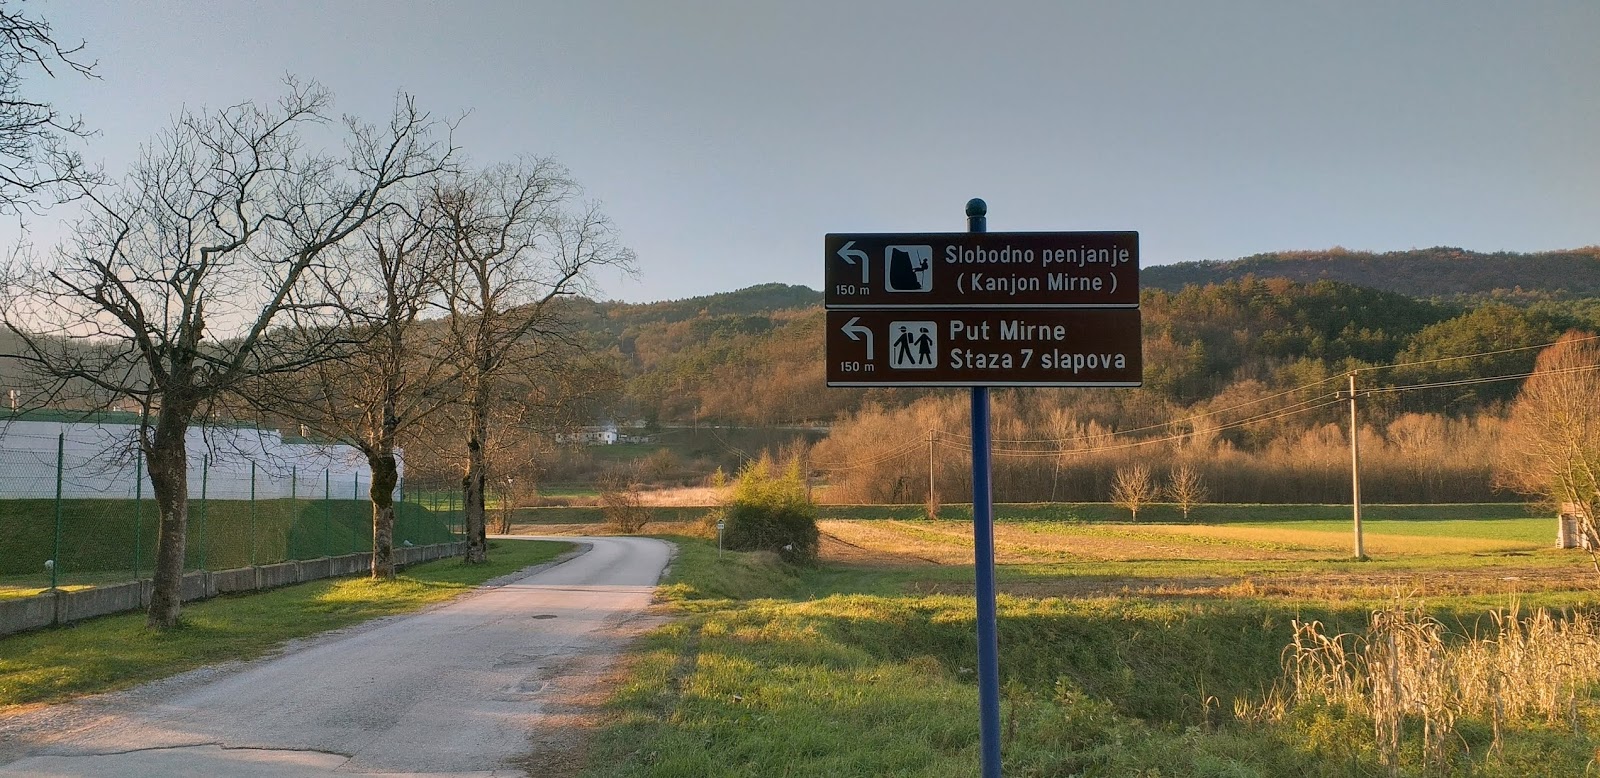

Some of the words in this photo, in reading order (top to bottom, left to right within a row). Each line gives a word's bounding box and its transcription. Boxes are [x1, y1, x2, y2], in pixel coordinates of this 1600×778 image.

[945, 245, 1034, 264] Slobodno
[1043, 245, 1129, 267] penjanje
[836, 285, 855, 295] 150
[860, 287, 870, 295] m
[971, 273, 1040, 295] Kanjon
[1048, 273, 1102, 291] Mirne
[950, 320, 990, 341] Put
[1000, 320, 1066, 341] Mirne
[840, 361, 860, 372] 150
[864, 364, 874, 372] m
[950, 349, 1013, 369] Staza
[1020, 349, 1033, 369] 7
[1041, 348, 1126, 374] slapova
